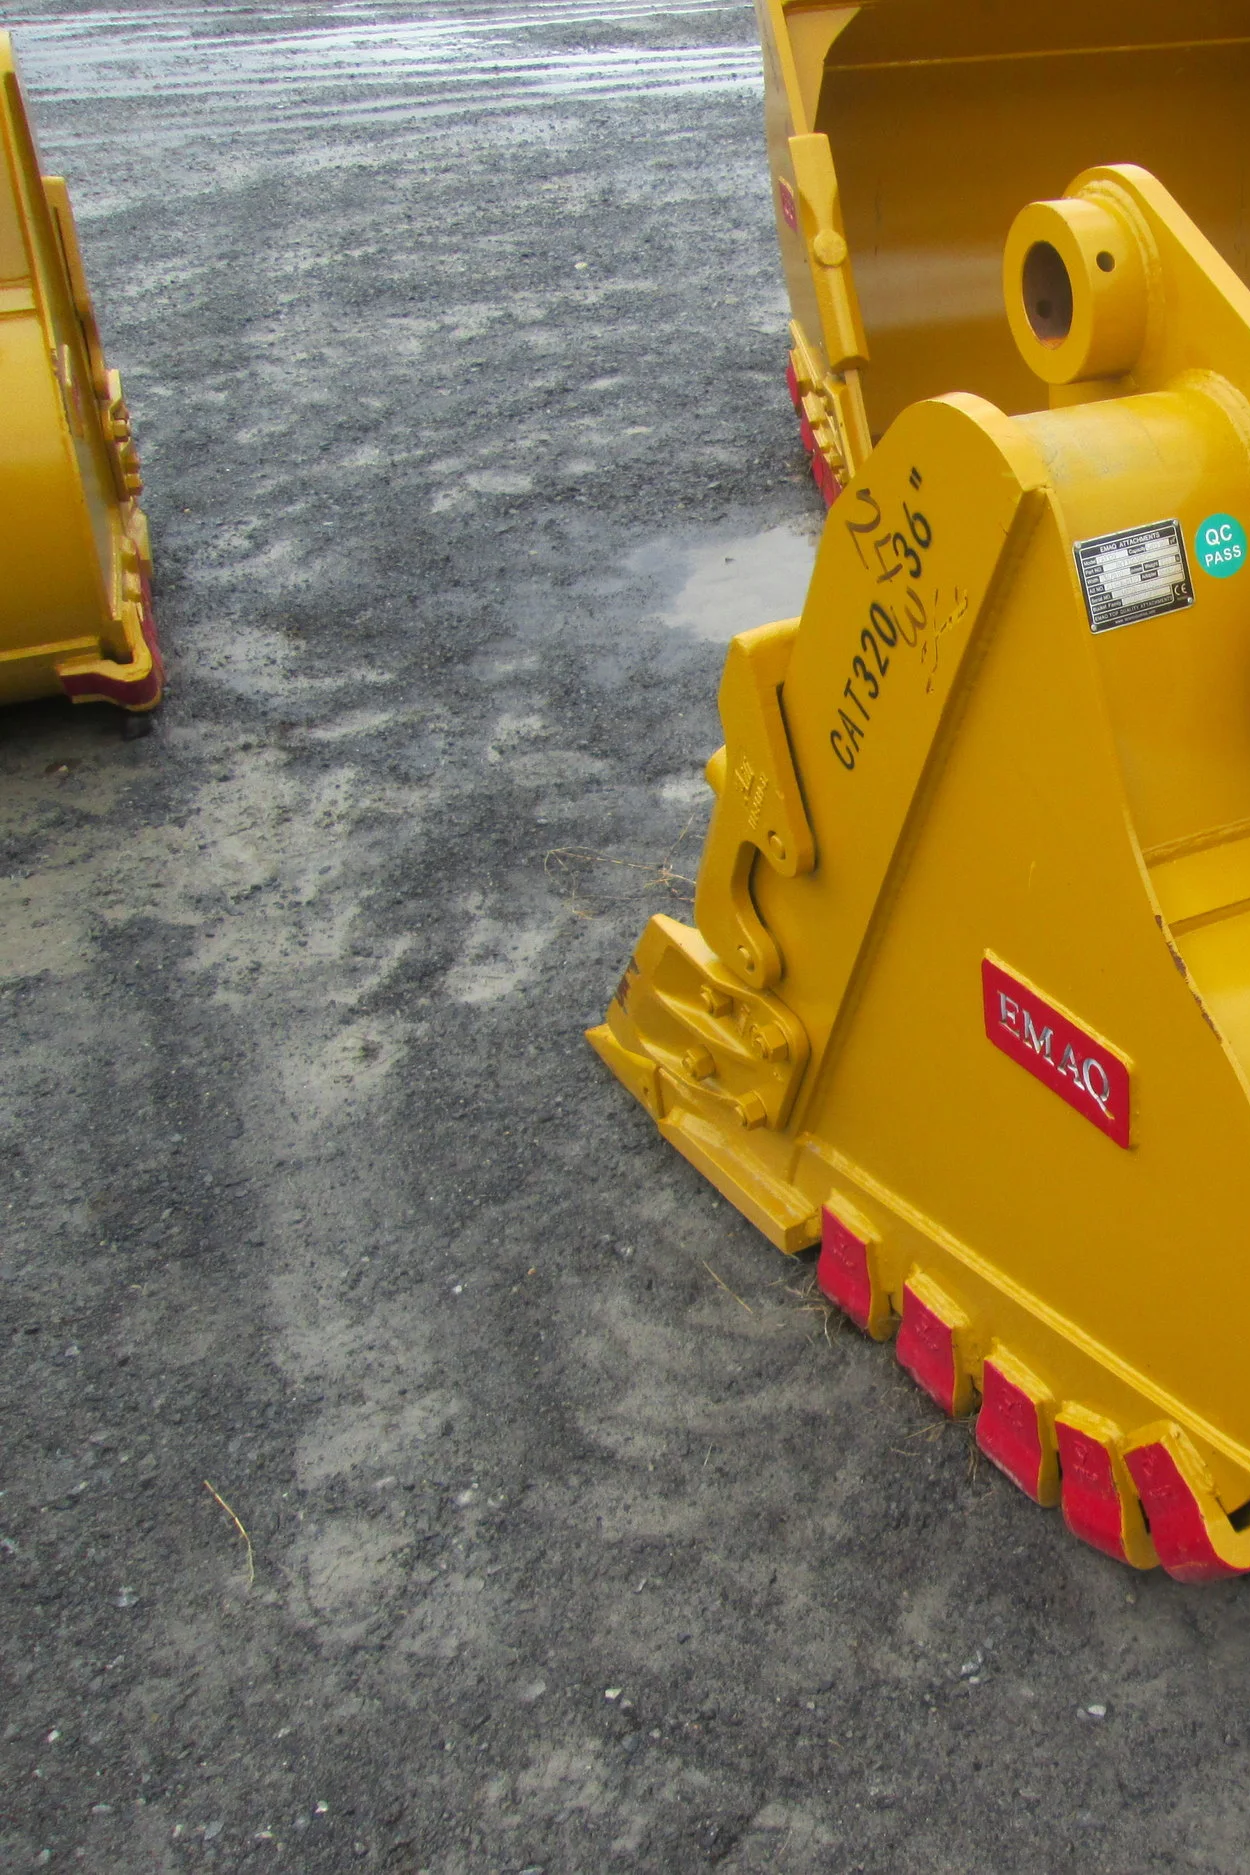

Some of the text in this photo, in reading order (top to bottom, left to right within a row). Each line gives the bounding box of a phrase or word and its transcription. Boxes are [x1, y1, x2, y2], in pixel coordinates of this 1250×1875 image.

[1118, 531, 1160, 547] ATTACHMENTS
[1205, 524, 1234, 546] QC
[1204, 545, 1242, 567] PASS
[829, 466, 932, 770] CAT320 36"
[997, 990, 1115, 1120] EMAQ
